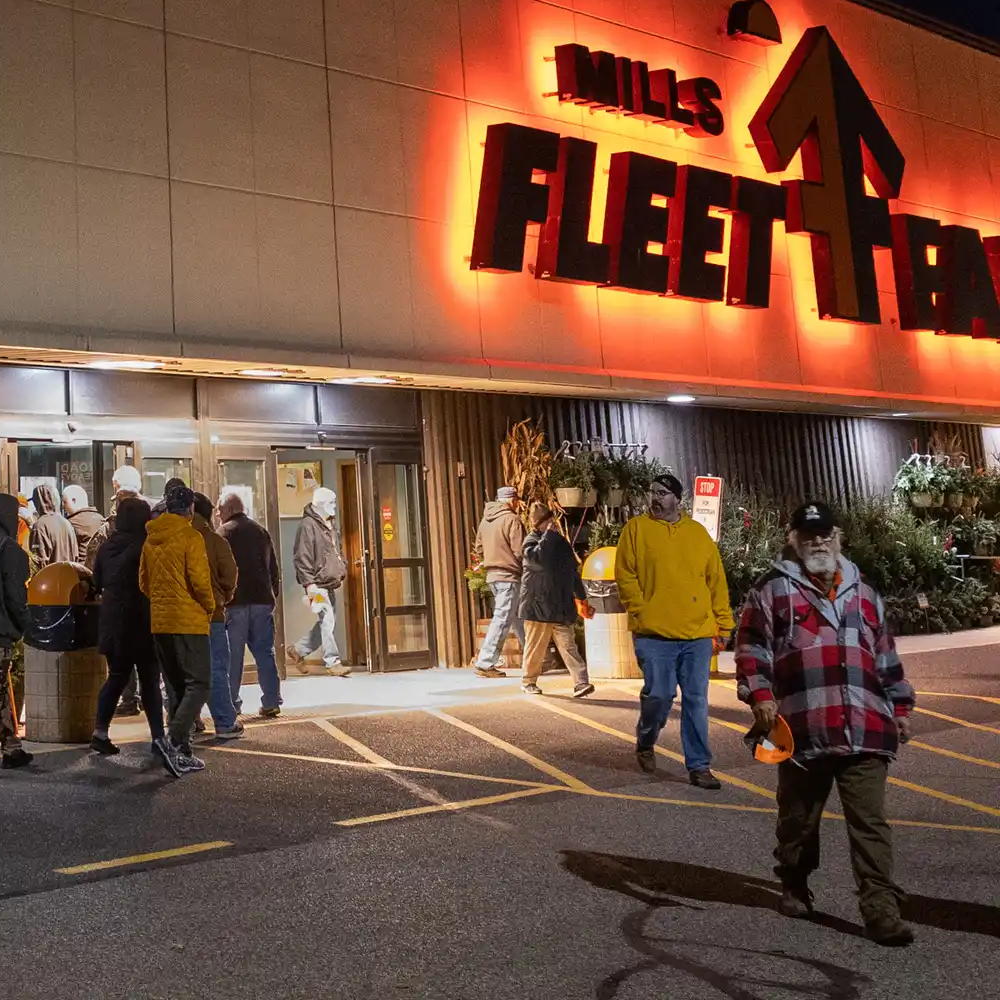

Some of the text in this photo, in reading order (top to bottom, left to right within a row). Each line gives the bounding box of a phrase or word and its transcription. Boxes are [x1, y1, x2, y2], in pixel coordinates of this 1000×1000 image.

[555, 43, 724, 138] MILLS
[470, 122, 788, 309] FLEET
[700, 482, 714, 494] STOP
